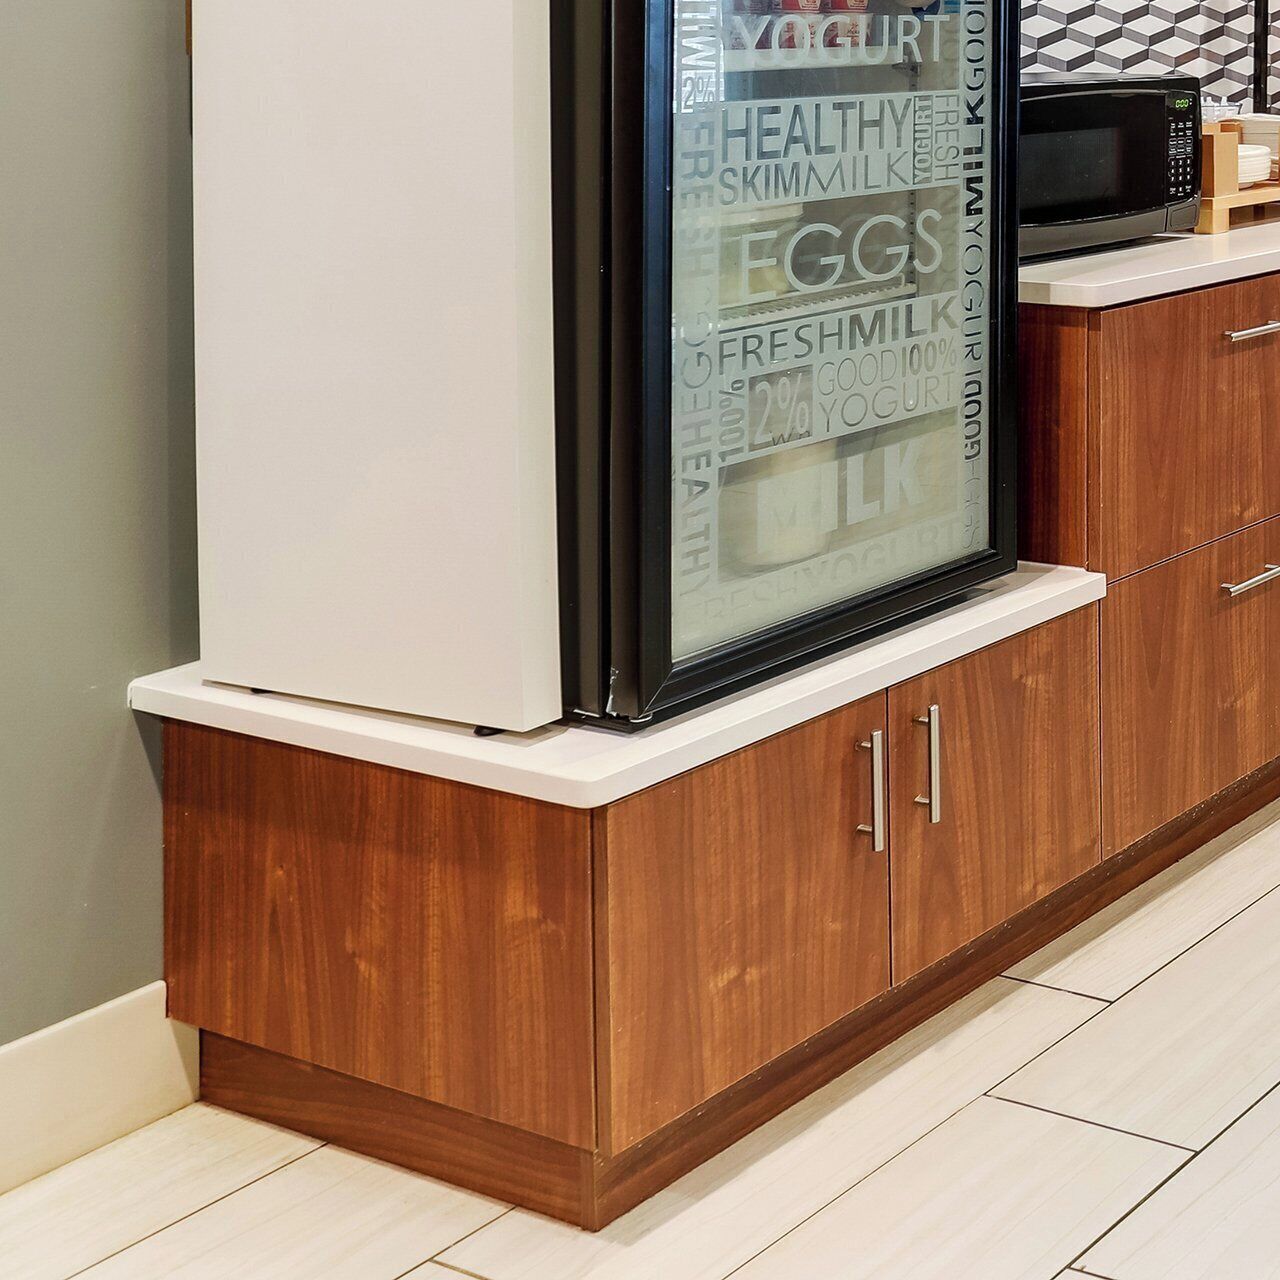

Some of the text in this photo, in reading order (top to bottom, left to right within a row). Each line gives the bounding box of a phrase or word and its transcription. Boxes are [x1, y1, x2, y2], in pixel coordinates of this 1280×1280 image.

[732, 14, 950, 65] YOGURT
[722, 98, 912, 164] HEALTHY
[934, 95, 960, 182] FRESH
[741, 208, 943, 303] EGGS
[818, 373, 955, 433] YOGURT
